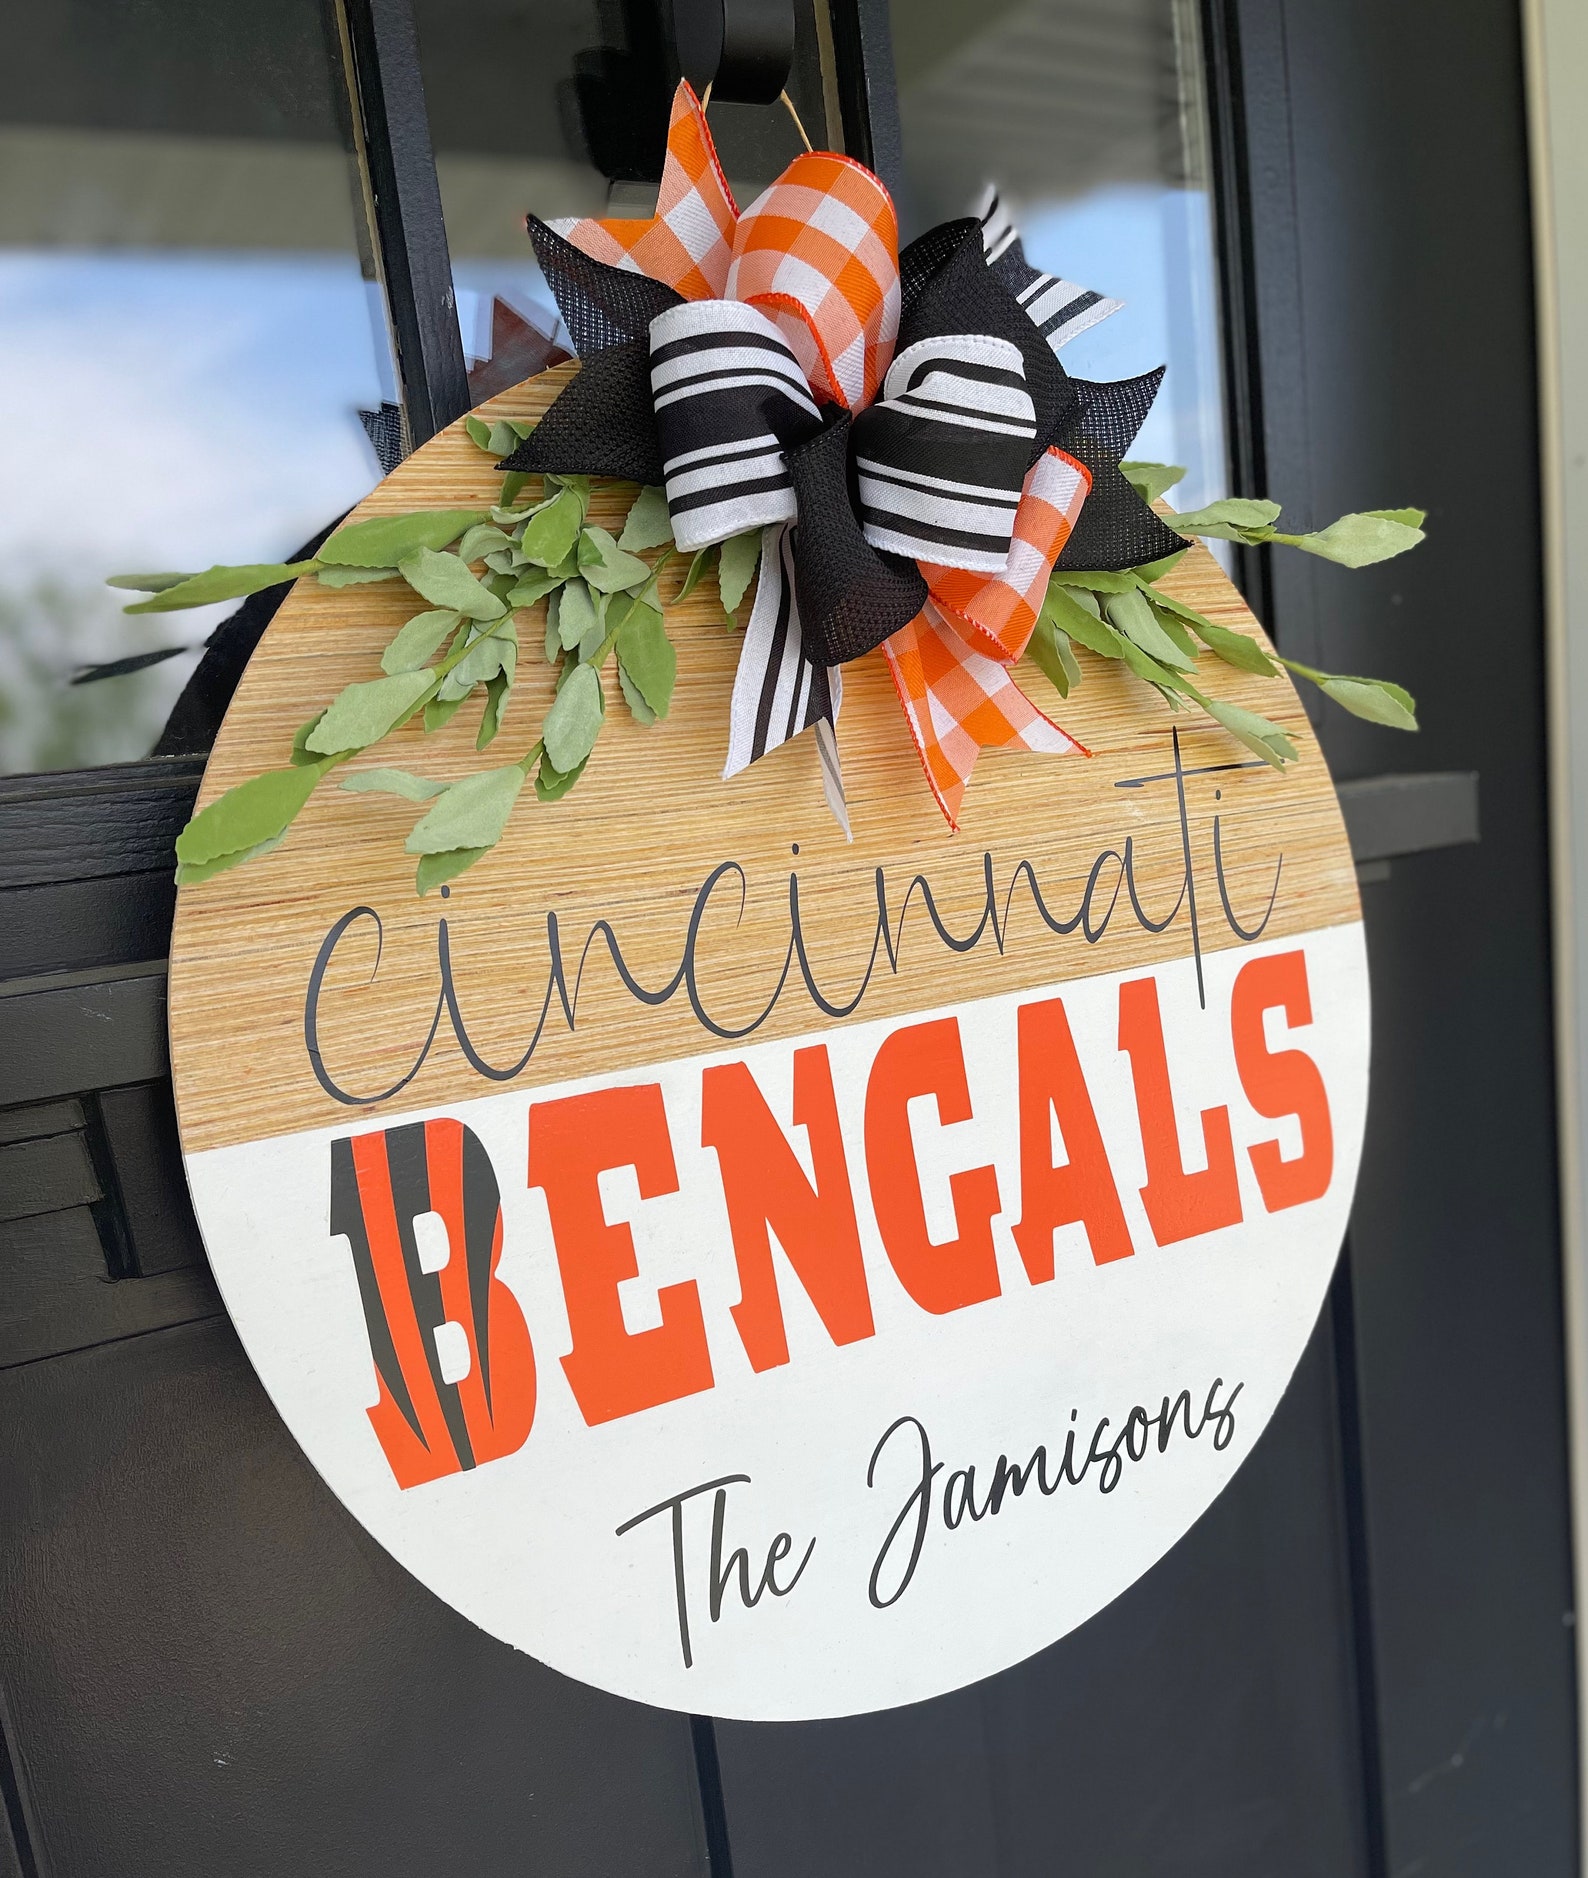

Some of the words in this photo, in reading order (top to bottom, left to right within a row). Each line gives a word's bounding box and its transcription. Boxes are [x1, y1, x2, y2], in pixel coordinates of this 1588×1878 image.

[304, 726, 1286, 1105] cincinnati
[329, 949, 1334, 1491] BENGALS
[615, 1473, 816, 1668] The
[867, 1377, 1245, 1608] Jamisons
